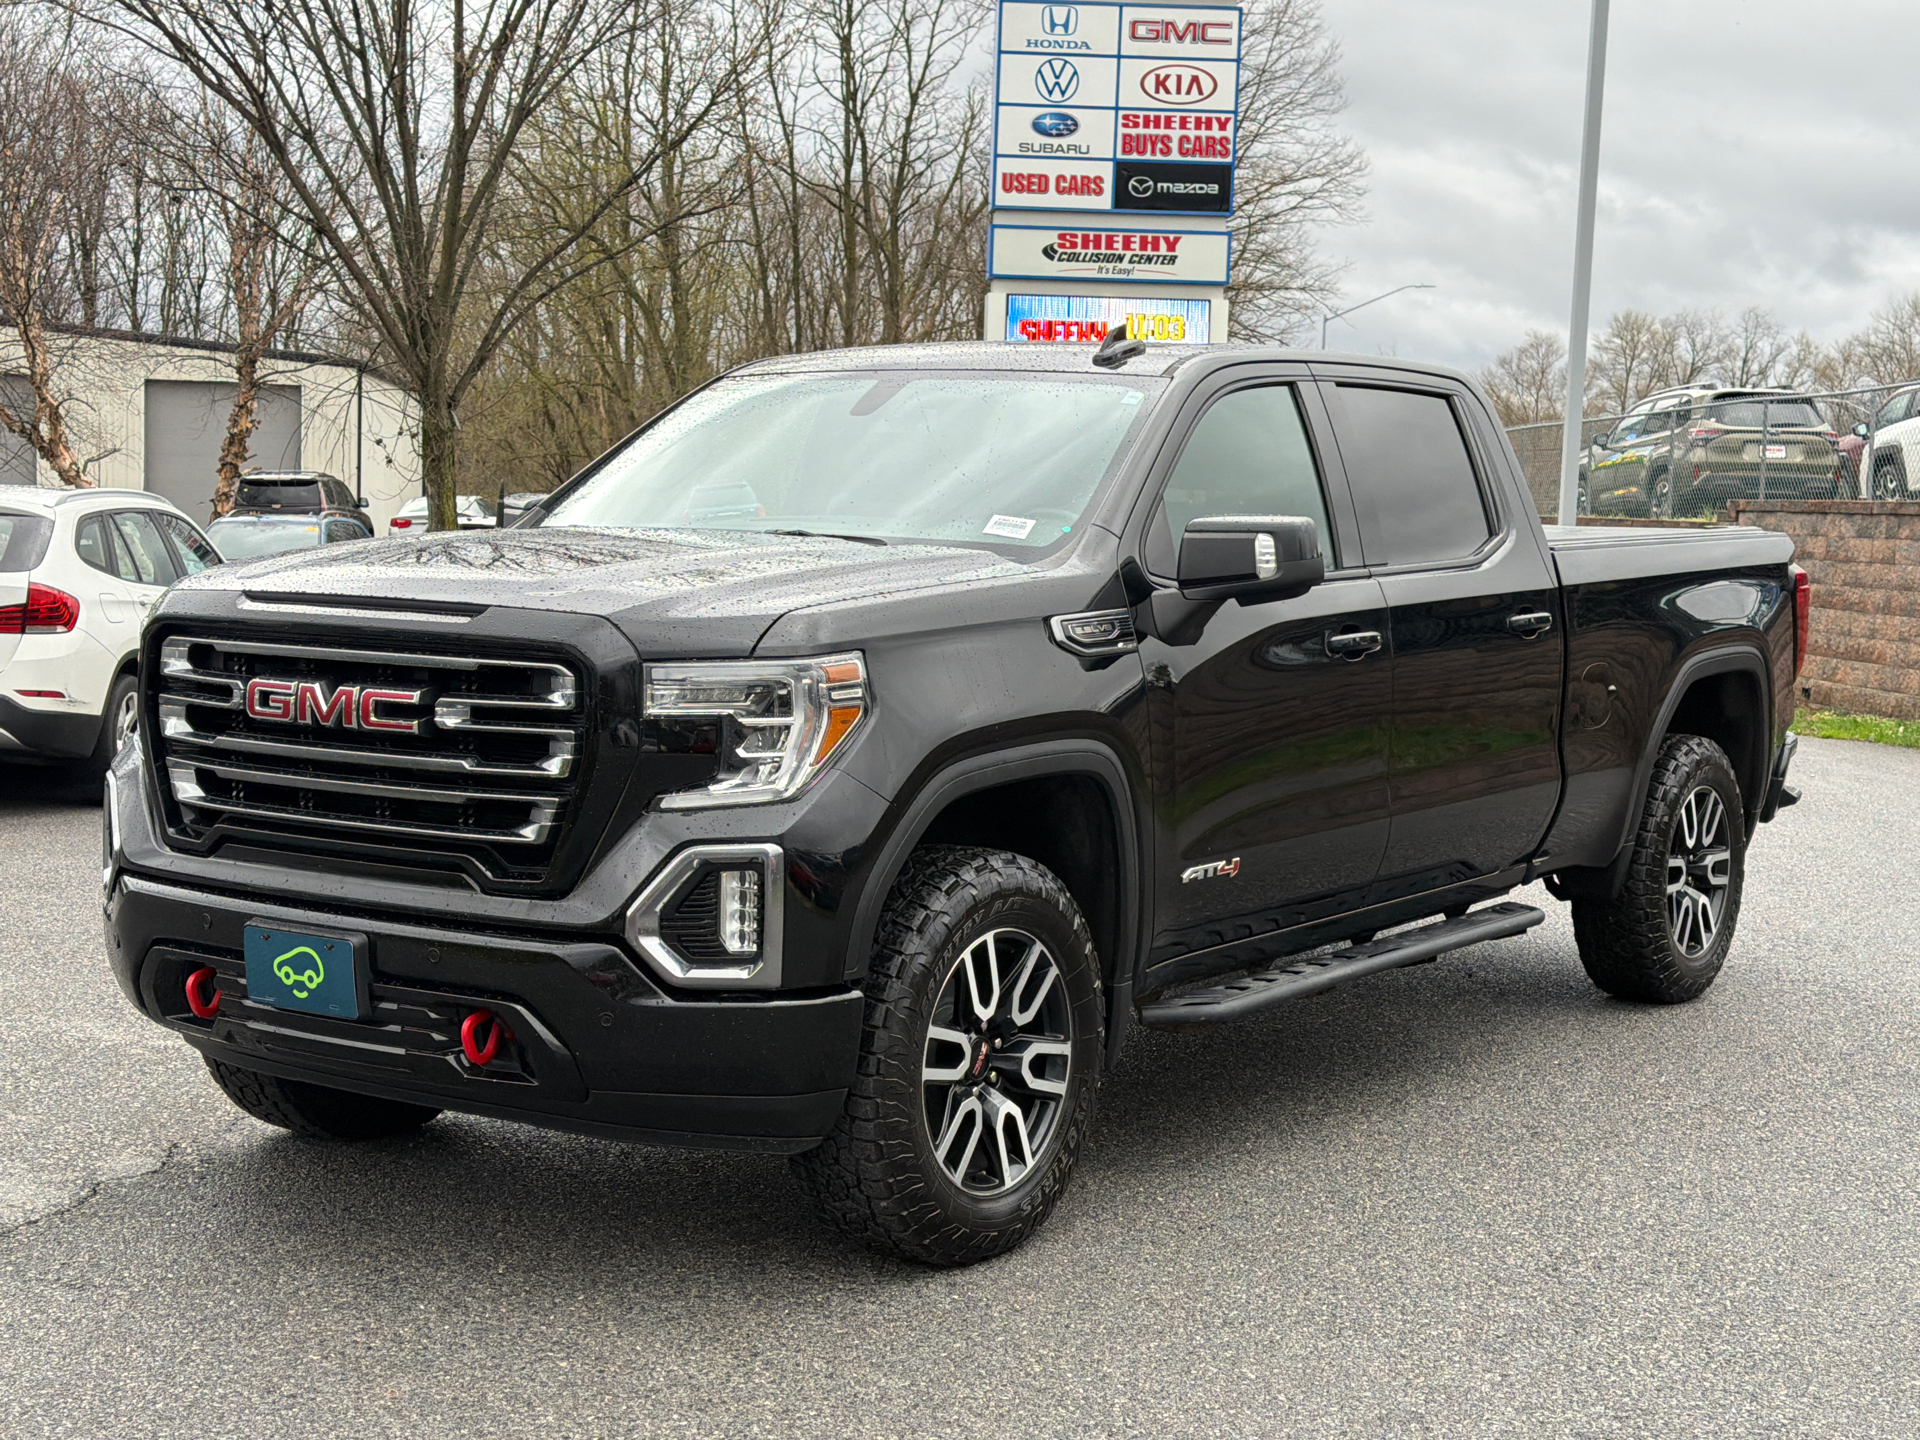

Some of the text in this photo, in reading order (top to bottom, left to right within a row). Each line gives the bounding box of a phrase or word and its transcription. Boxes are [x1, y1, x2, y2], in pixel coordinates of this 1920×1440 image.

[1129, 18, 1232, 45] GMC
[1025, 39, 1092, 50] HONDA
[1154, 74, 1204, 96] KIA
[1121, 114, 1232, 132] SHEEHY
[1018, 142, 1090, 155] SUBARU
[1121, 134, 1231, 158] BUYS CARS
[1002, 172, 1104, 196] USED CARS
[1156, 181, 1219, 195] mazda
[1057, 232, 1182, 253] SHEEHY
[1057, 251, 1178, 265] COLLISION CENTER
[1097, 265, 1135, 277] It's Easy!
[246, 678, 420, 735] GMC
[1180, 857, 1240, 883] AT4
